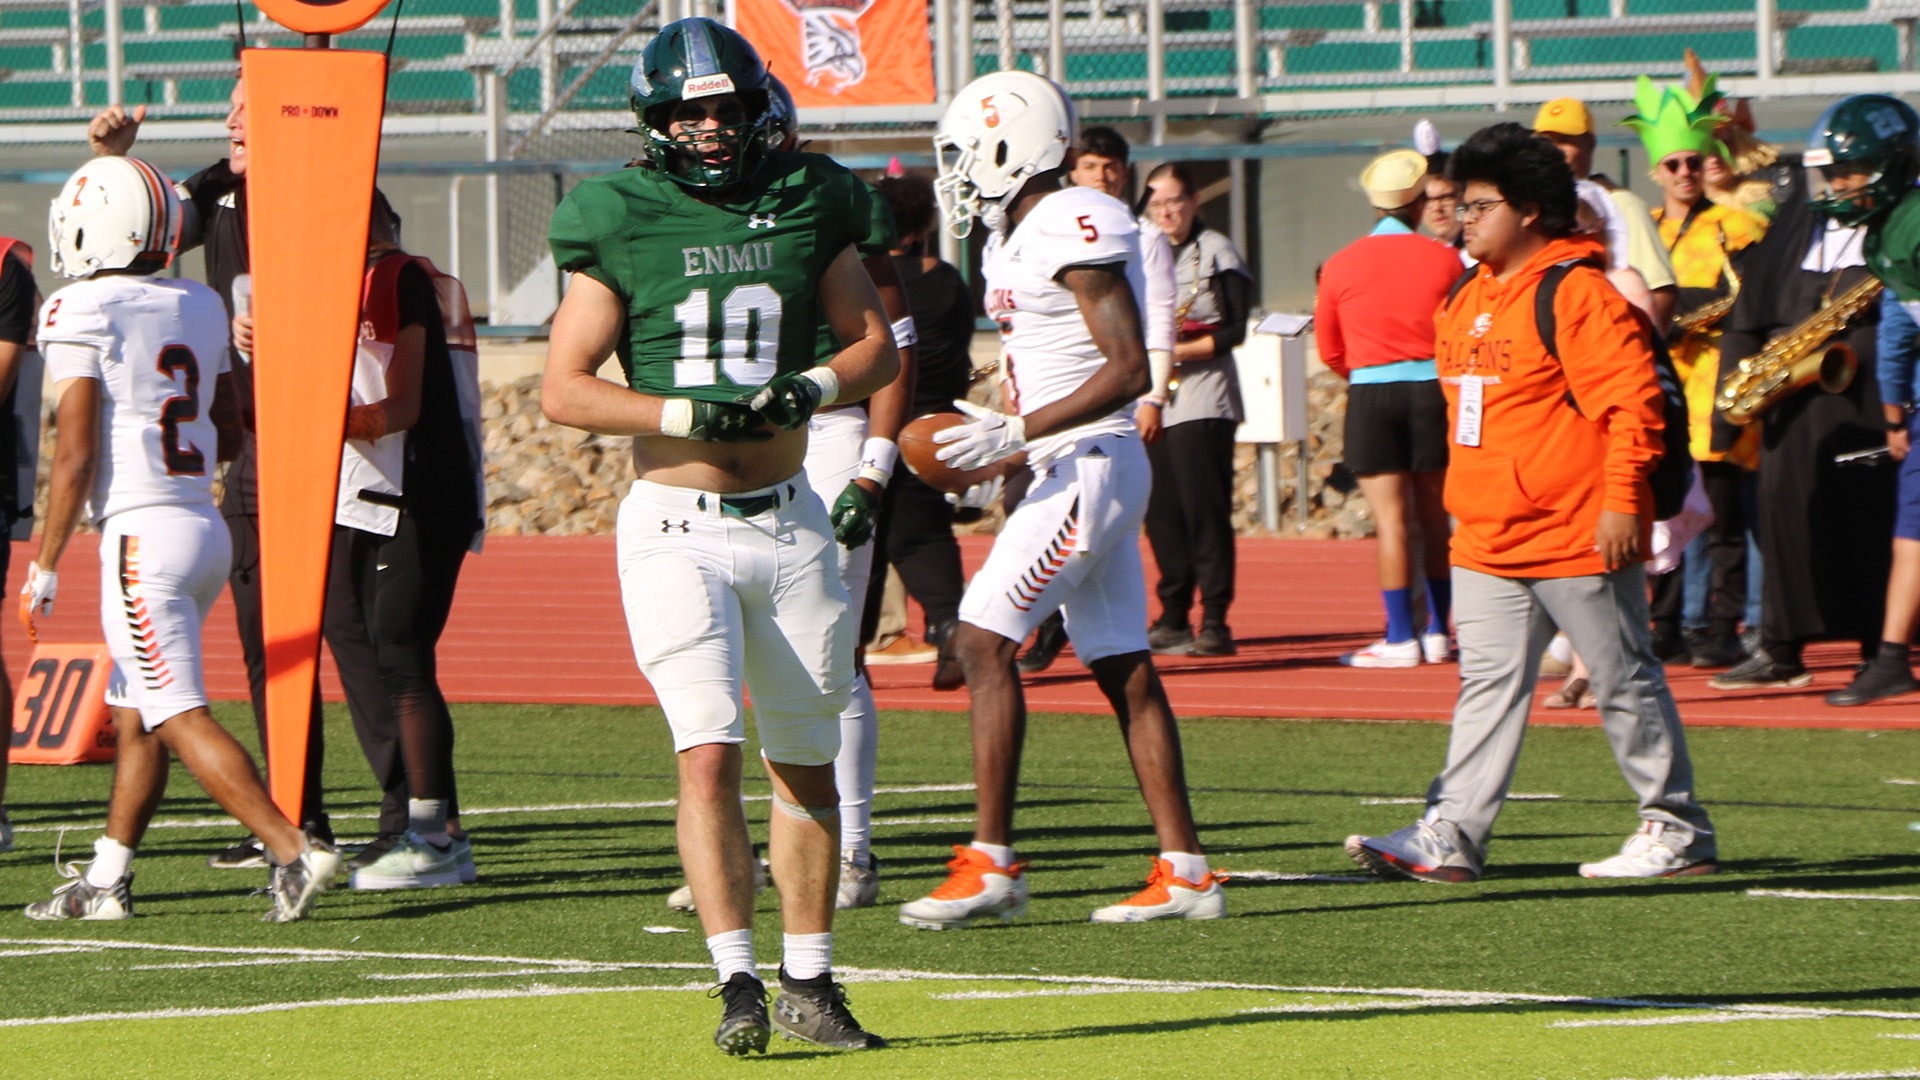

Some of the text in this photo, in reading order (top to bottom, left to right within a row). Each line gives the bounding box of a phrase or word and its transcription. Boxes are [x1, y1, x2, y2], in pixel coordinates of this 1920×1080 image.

[688, 79, 729, 92] Riddell
[981, 95, 1000, 128] 5
[72, 176, 88, 207] 2
[1076, 215, 1098, 244] 5
[682, 242, 773, 276] ENMU
[45, 299, 62, 328] 2
[674, 283, 782, 387] 10
[1440, 339, 1512, 373] ALONS
[156, 344, 206, 476] 2
[10, 658, 94, 749] 30
